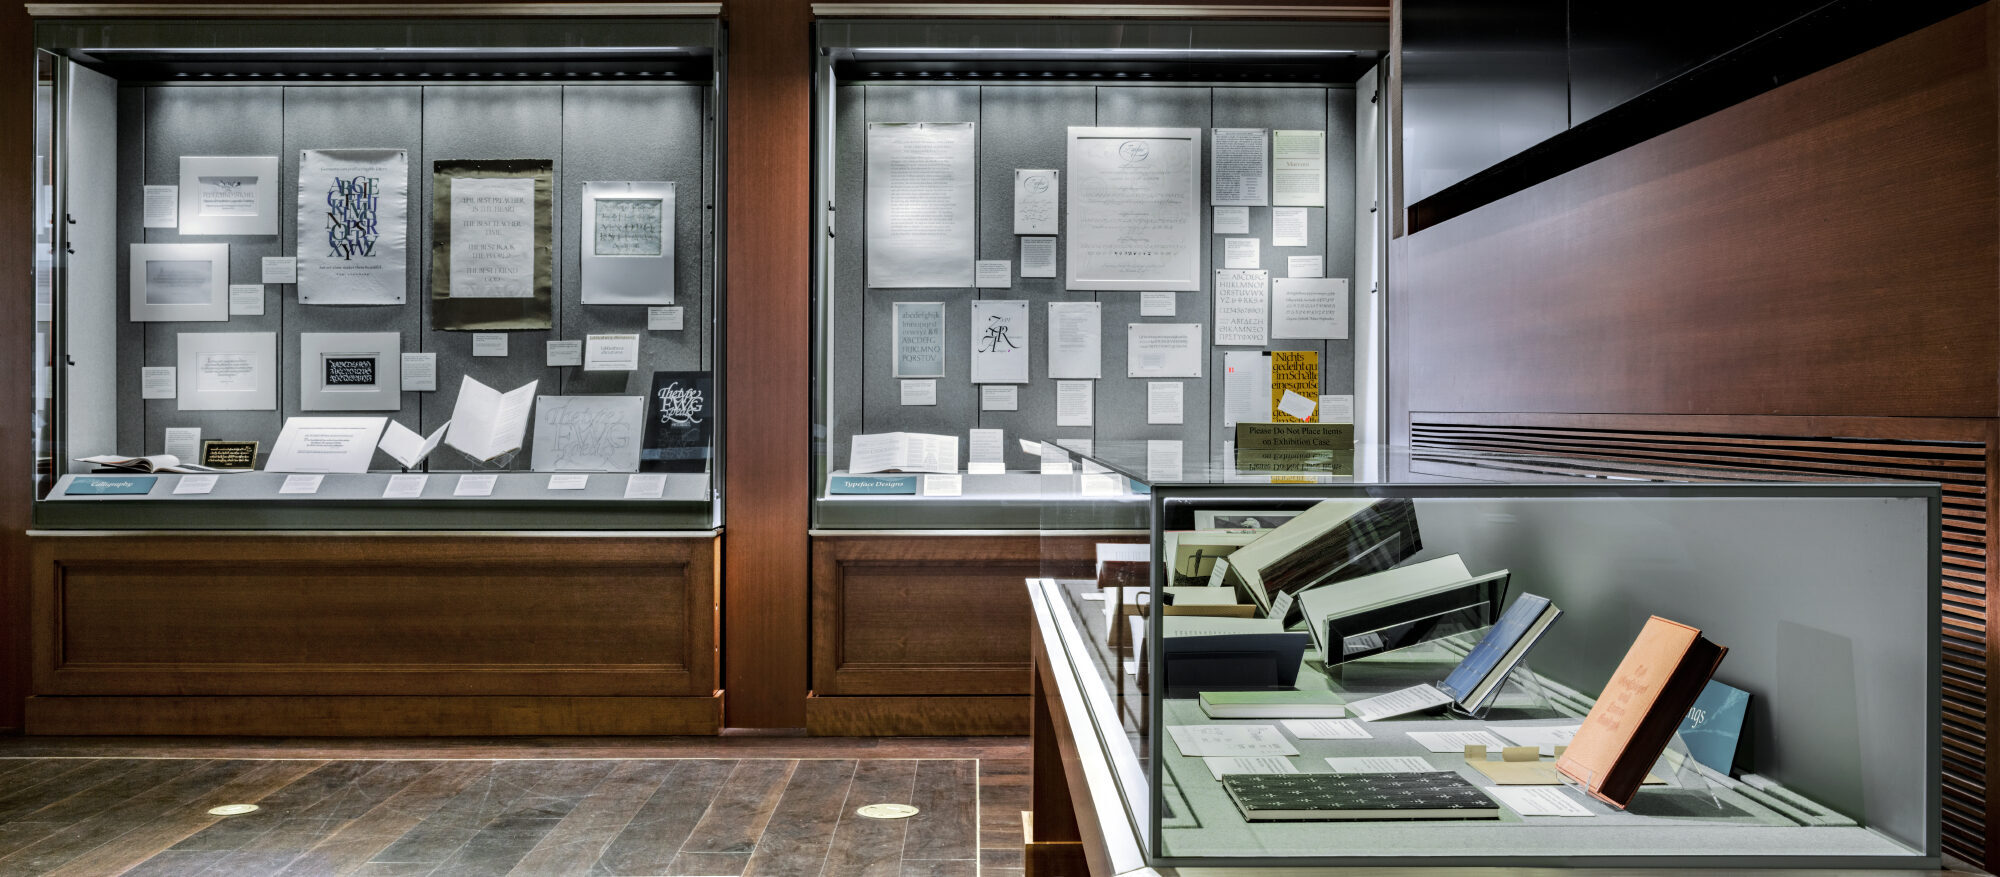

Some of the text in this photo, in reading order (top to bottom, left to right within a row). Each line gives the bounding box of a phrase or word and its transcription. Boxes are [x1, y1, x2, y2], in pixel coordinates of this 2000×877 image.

[1249, 427, 1343, 435] Please Do Not Place Items
[1273, 438, 1311, 446] Exhibition
[1312, 438, 1330, 446] Case
